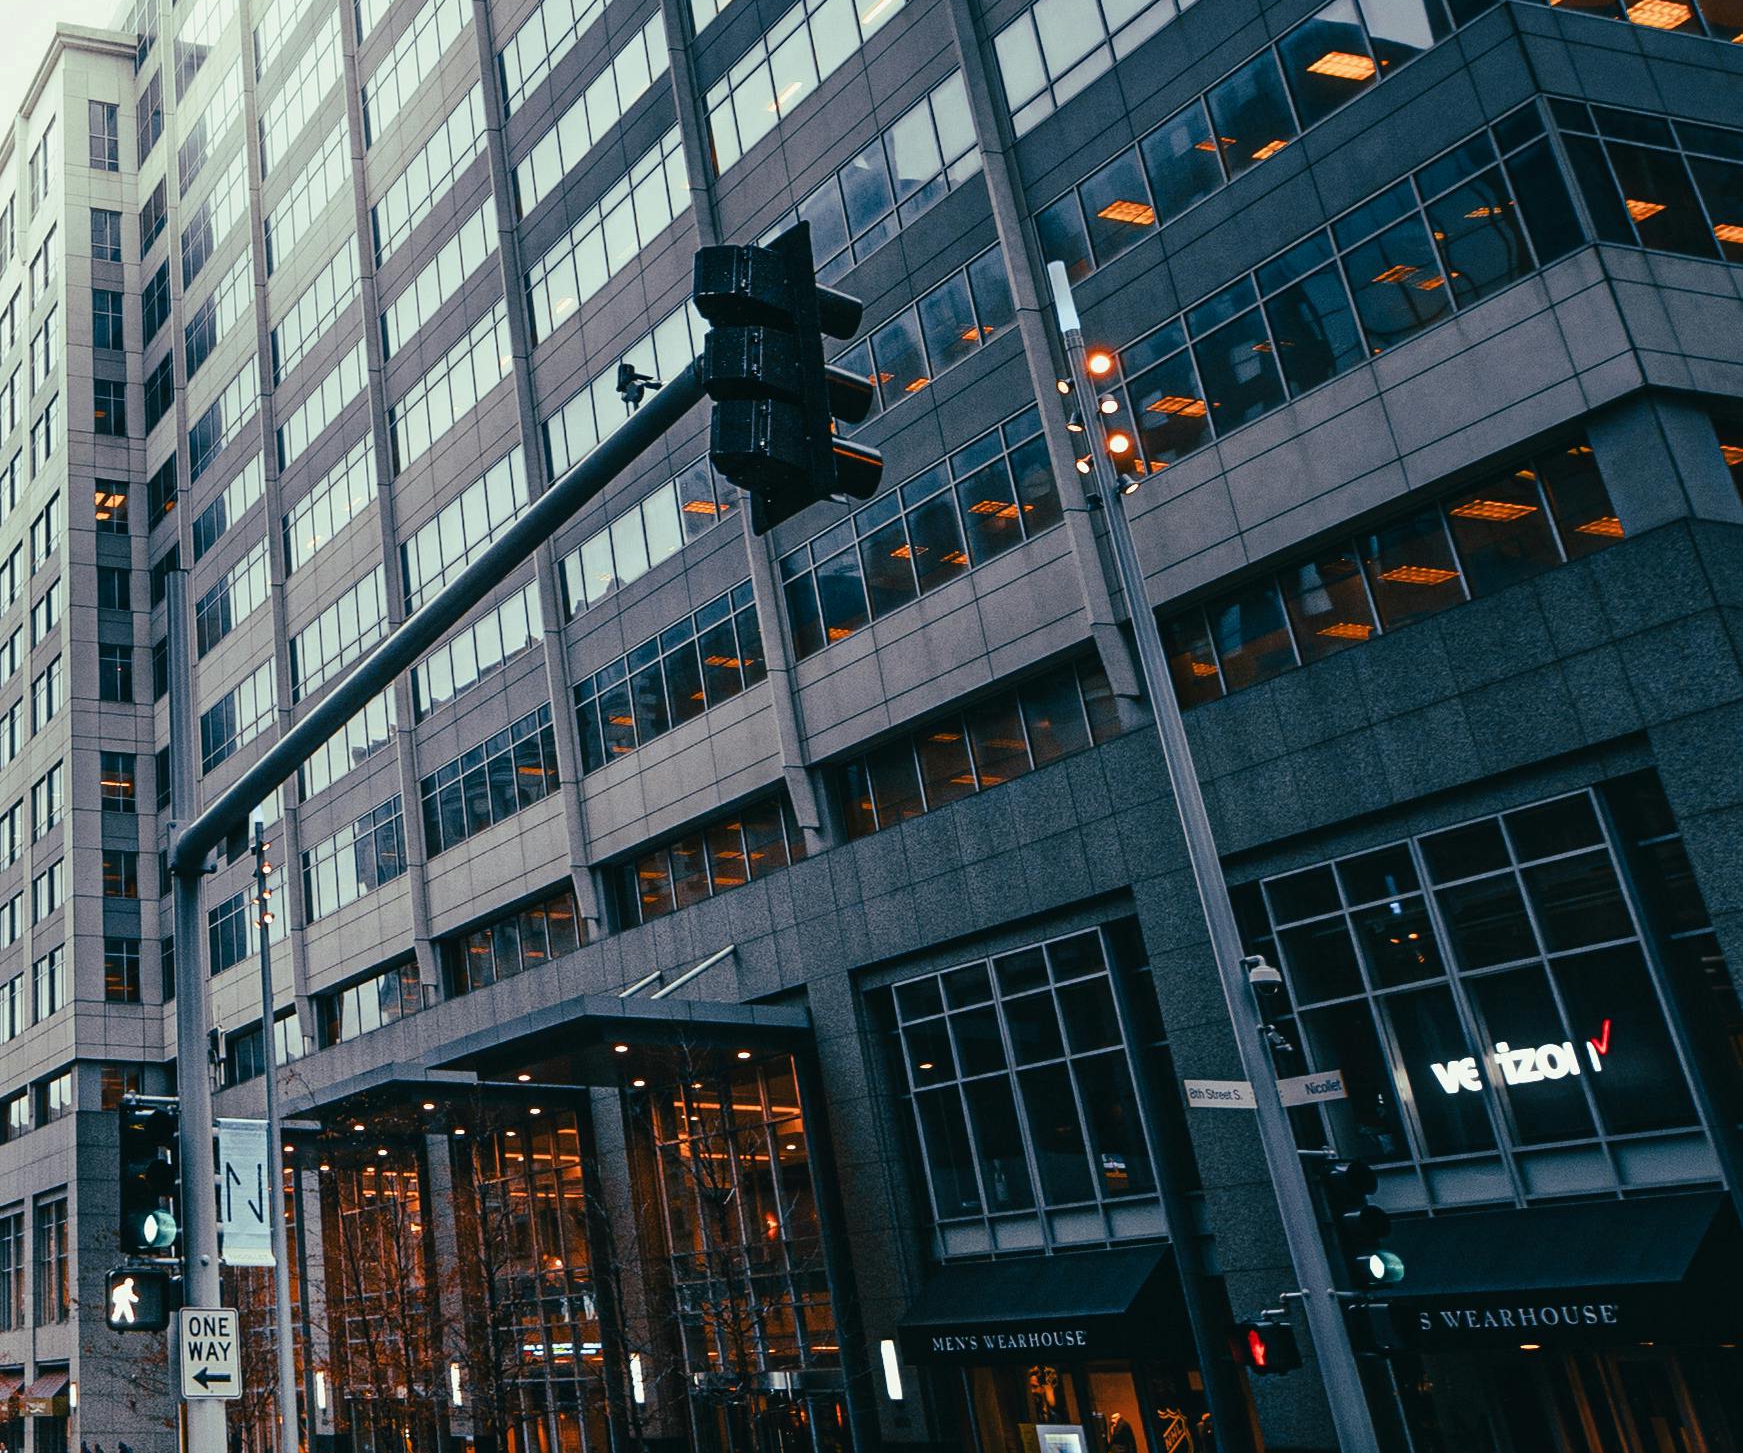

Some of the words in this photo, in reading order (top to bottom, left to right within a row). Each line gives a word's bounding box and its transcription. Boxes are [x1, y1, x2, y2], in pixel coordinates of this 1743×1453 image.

[1431, 1041, 1602, 1094] veizon
[1189, 1088, 1205, 1100] 8th
[1205, 1088, 1232, 1101] Street
[1304, 1079, 1342, 1096] Nicollet
[189, 1316, 230, 1337] ONE
[1440, 1304, 1617, 1329] WEARHOUSE
[932, 1335, 978, 1351] MEN'S
[983, 1330, 1087, 1350] WEARHOUSE
[188, 1341, 232, 1362] WAY
